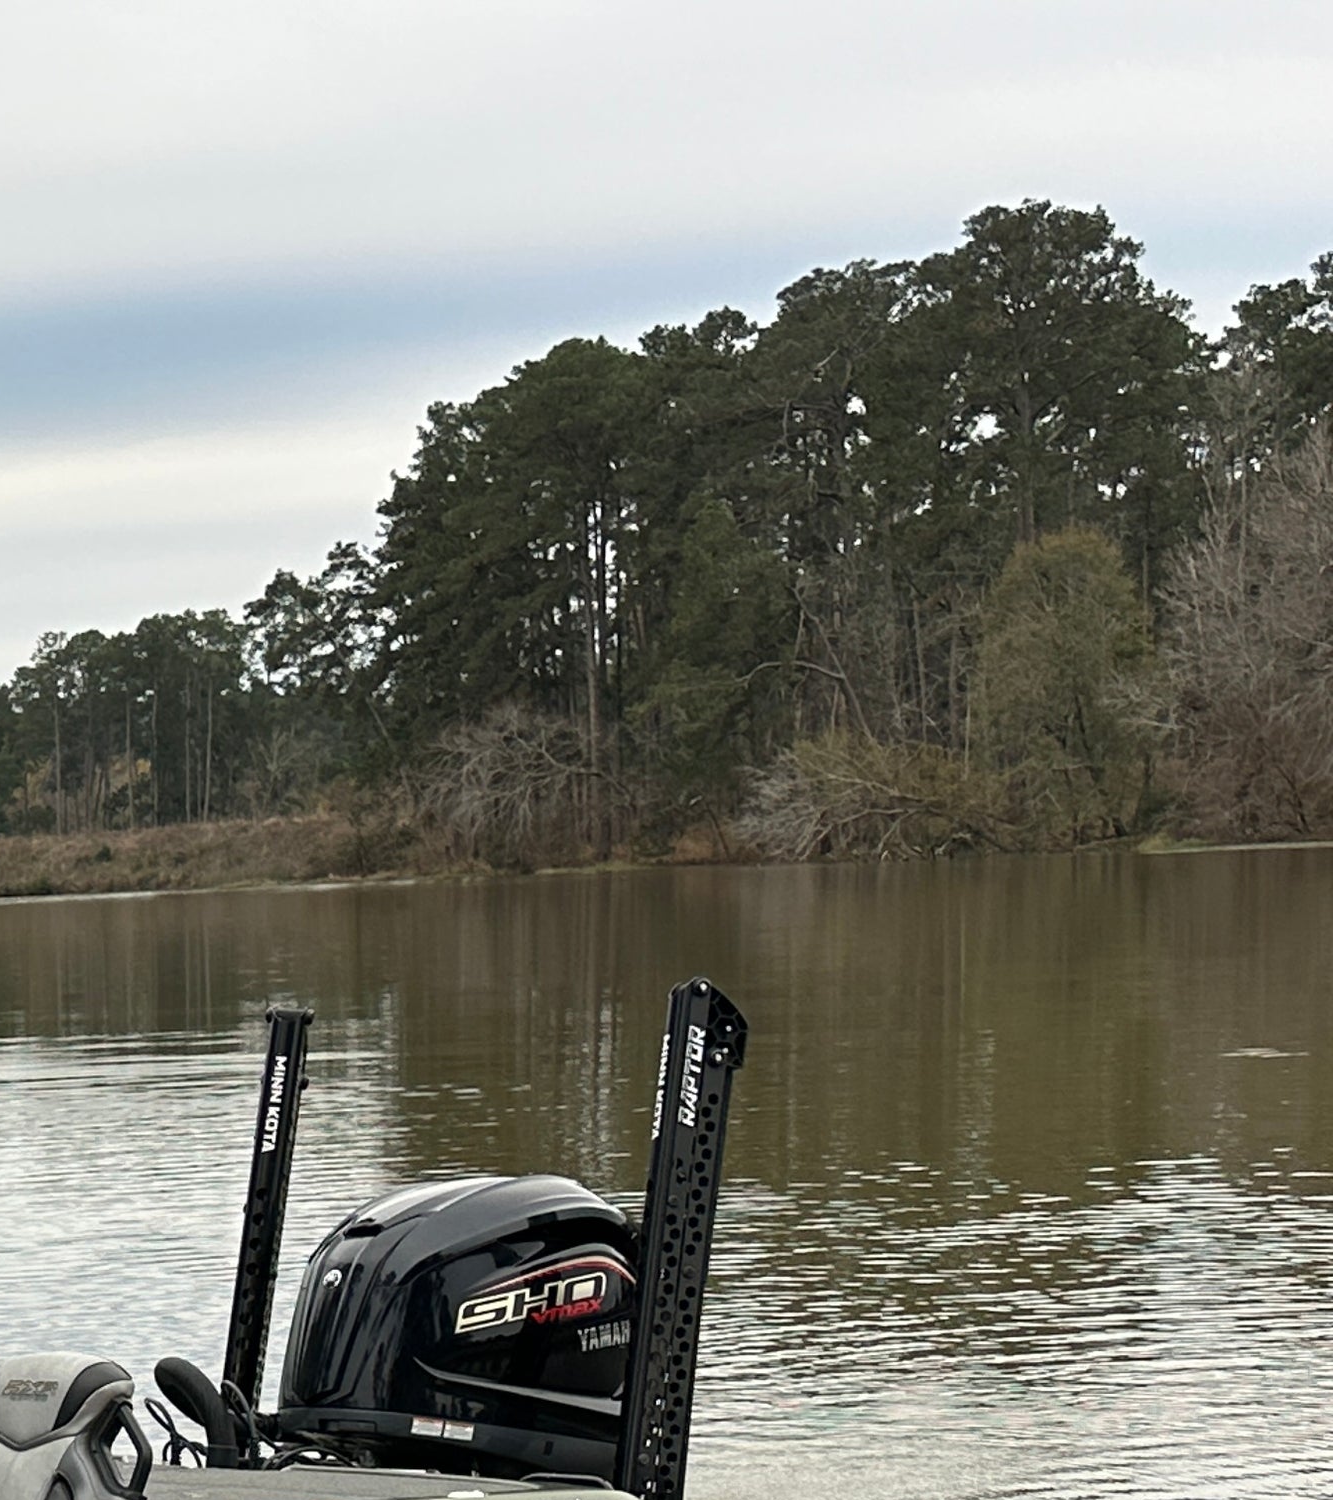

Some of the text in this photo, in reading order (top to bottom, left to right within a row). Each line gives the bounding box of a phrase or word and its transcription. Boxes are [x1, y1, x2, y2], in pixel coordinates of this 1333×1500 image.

[261, 1055, 288, 1154] MINN KOTA
[677, 1025, 707, 1128] RAPTOR
[454, 1271, 608, 1335] SHO
[577, 1319, 631, 1352] YAMAH
